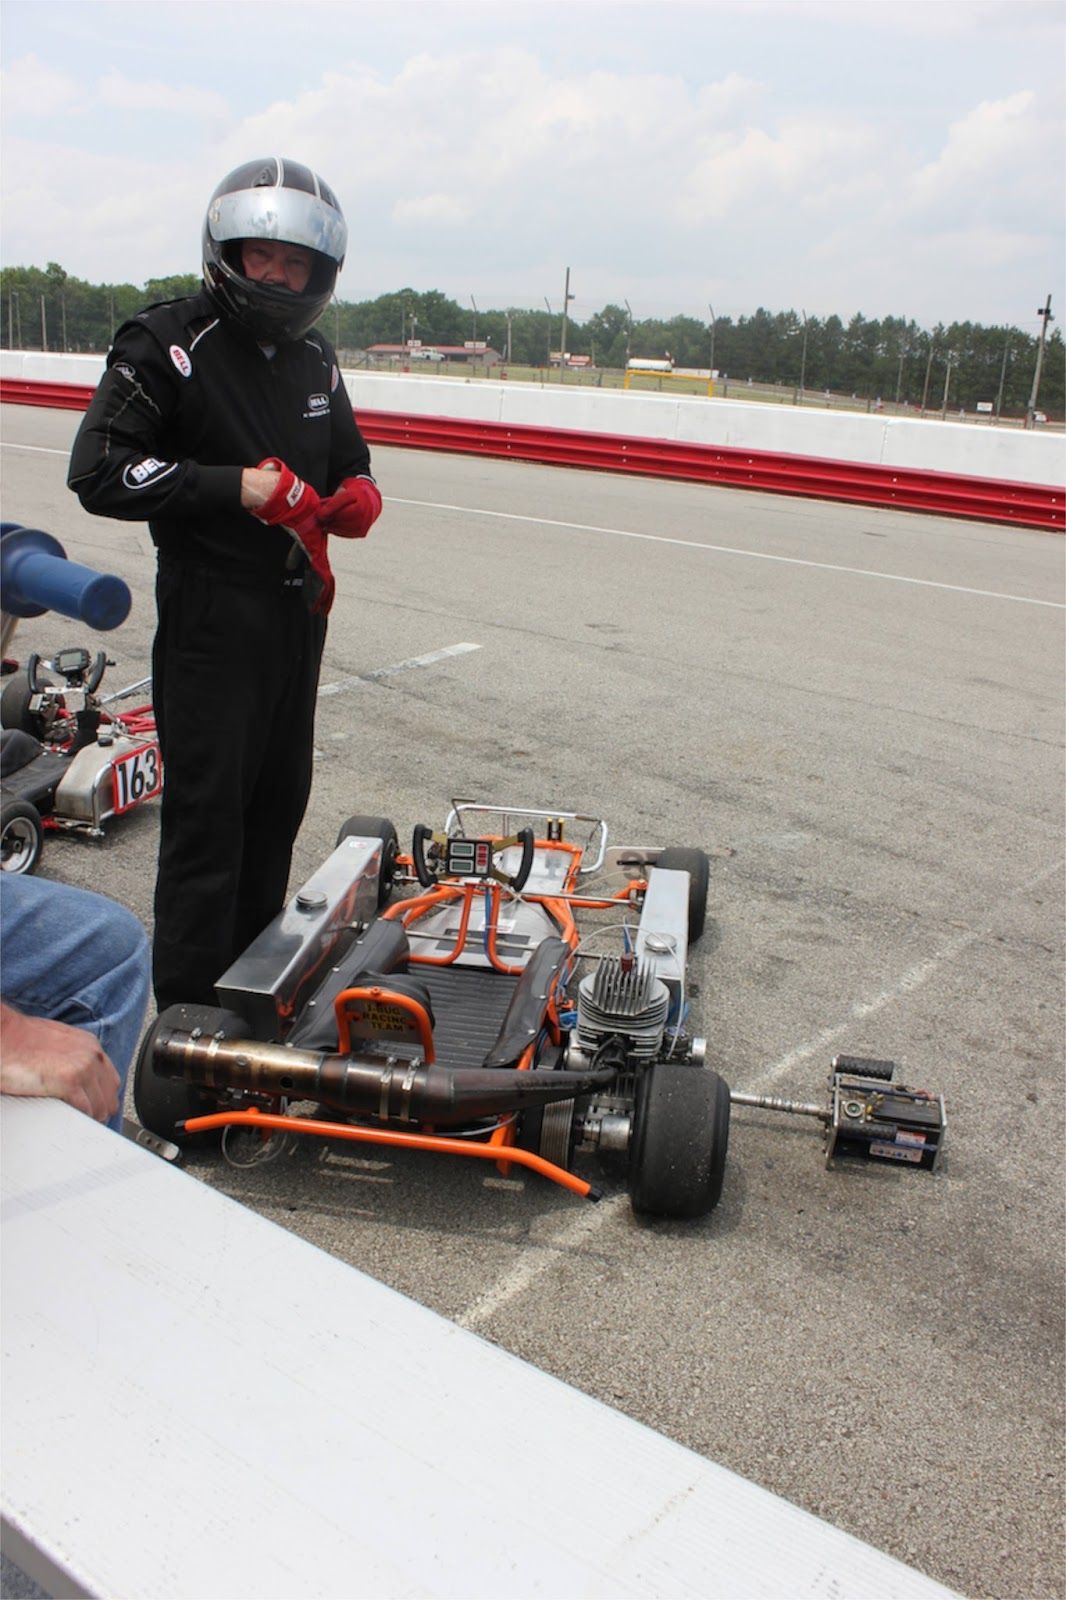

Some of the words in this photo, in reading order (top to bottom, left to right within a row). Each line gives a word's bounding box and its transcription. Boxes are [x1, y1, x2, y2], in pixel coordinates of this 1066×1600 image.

[173, 349, 189, 374] BELL
[130, 457, 167, 483] BEL
[118, 748, 158, 807] 163
[363, 1012, 407, 1025] RACING
[370, 1021, 404, 1032] TEAM
